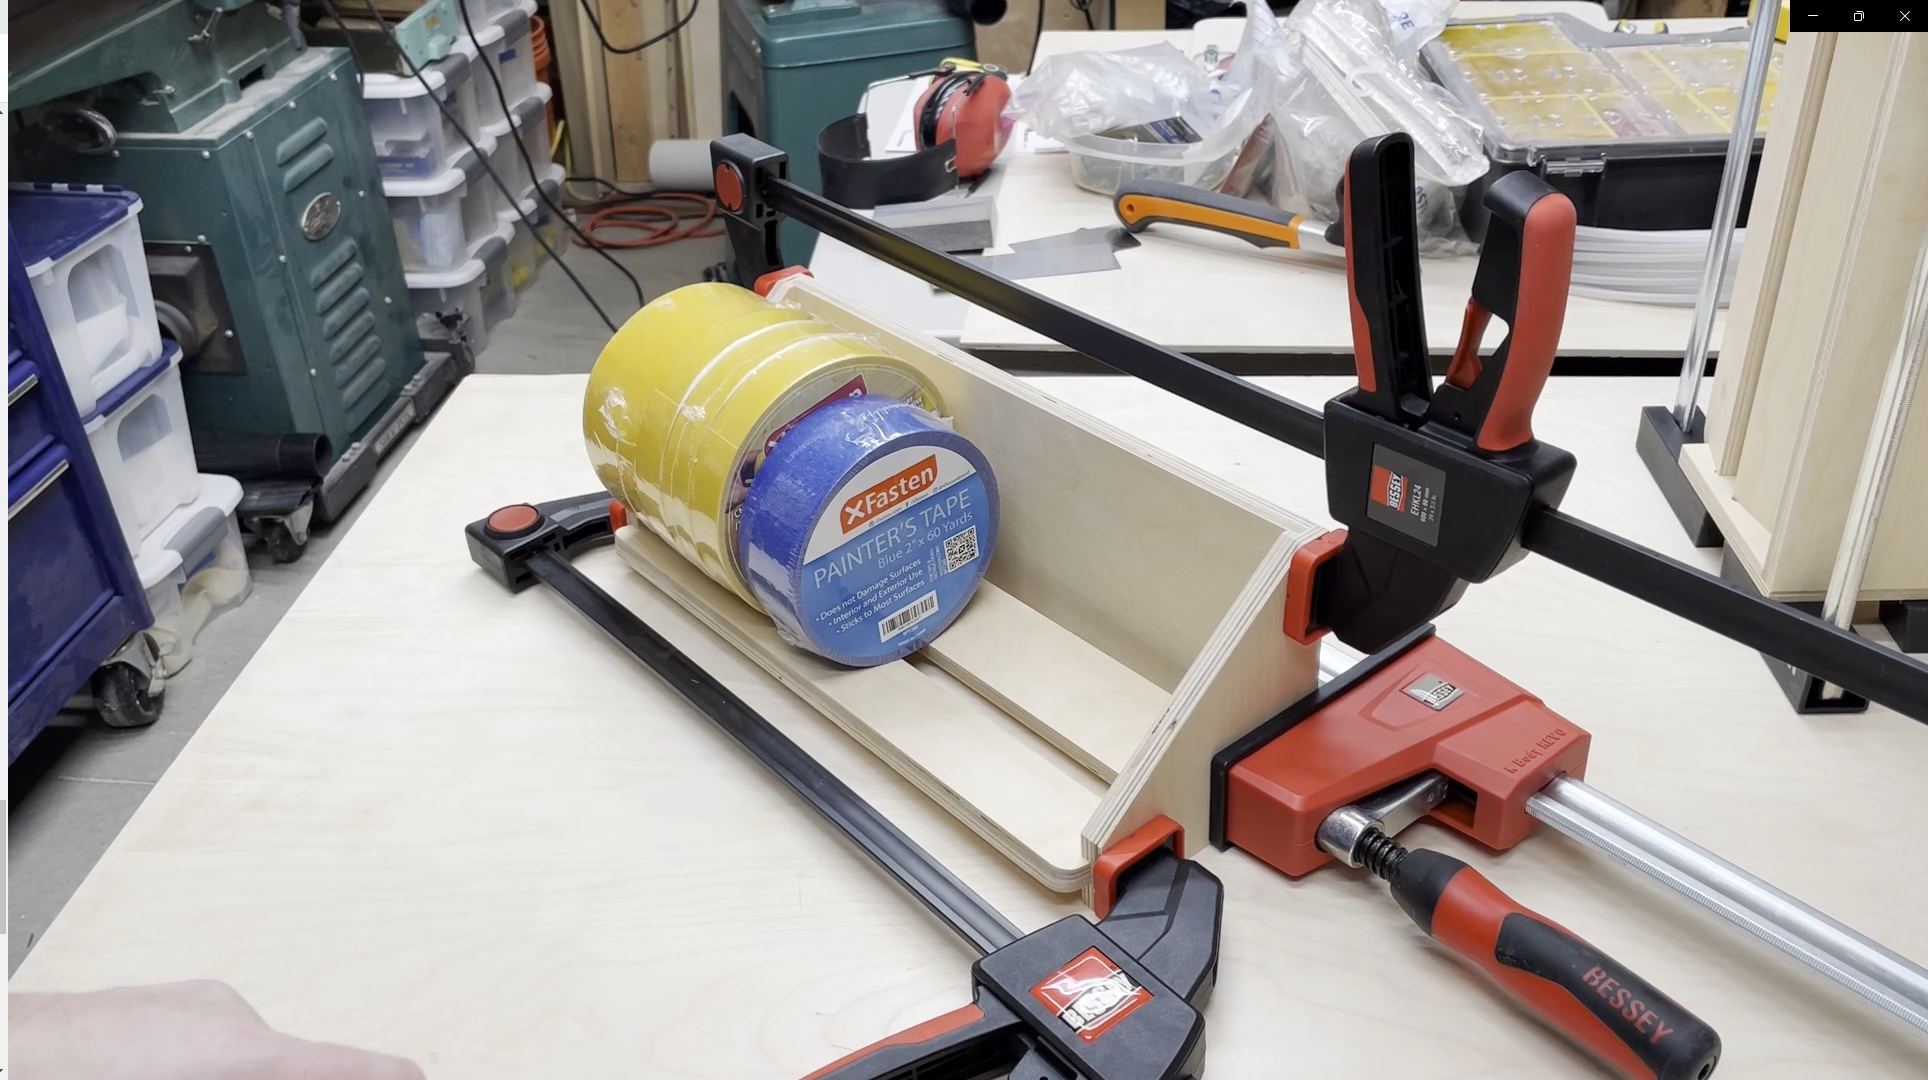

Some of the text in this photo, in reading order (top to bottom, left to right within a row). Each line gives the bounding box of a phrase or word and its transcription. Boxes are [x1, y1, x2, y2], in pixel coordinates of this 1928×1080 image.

[1389, 473, 1402, 508] BESSEY
[1410, 484, 1422, 516] EHKL24
[814, 488, 971, 589] PAINTER'S TAPE
[878, 550, 903, 570] Blue
[918, 538, 924, 546] x
[927, 528, 941, 541] 60
[942, 512, 972, 533] Yards
[820, 558, 921, 620] Does not Damage Surfaces
[833, 569, 923, 625] Interior and Exterior Use
[841, 580, 925, 632] Sticks to Most Surfaces
[1582, 966, 1674, 1044] BESSEY
